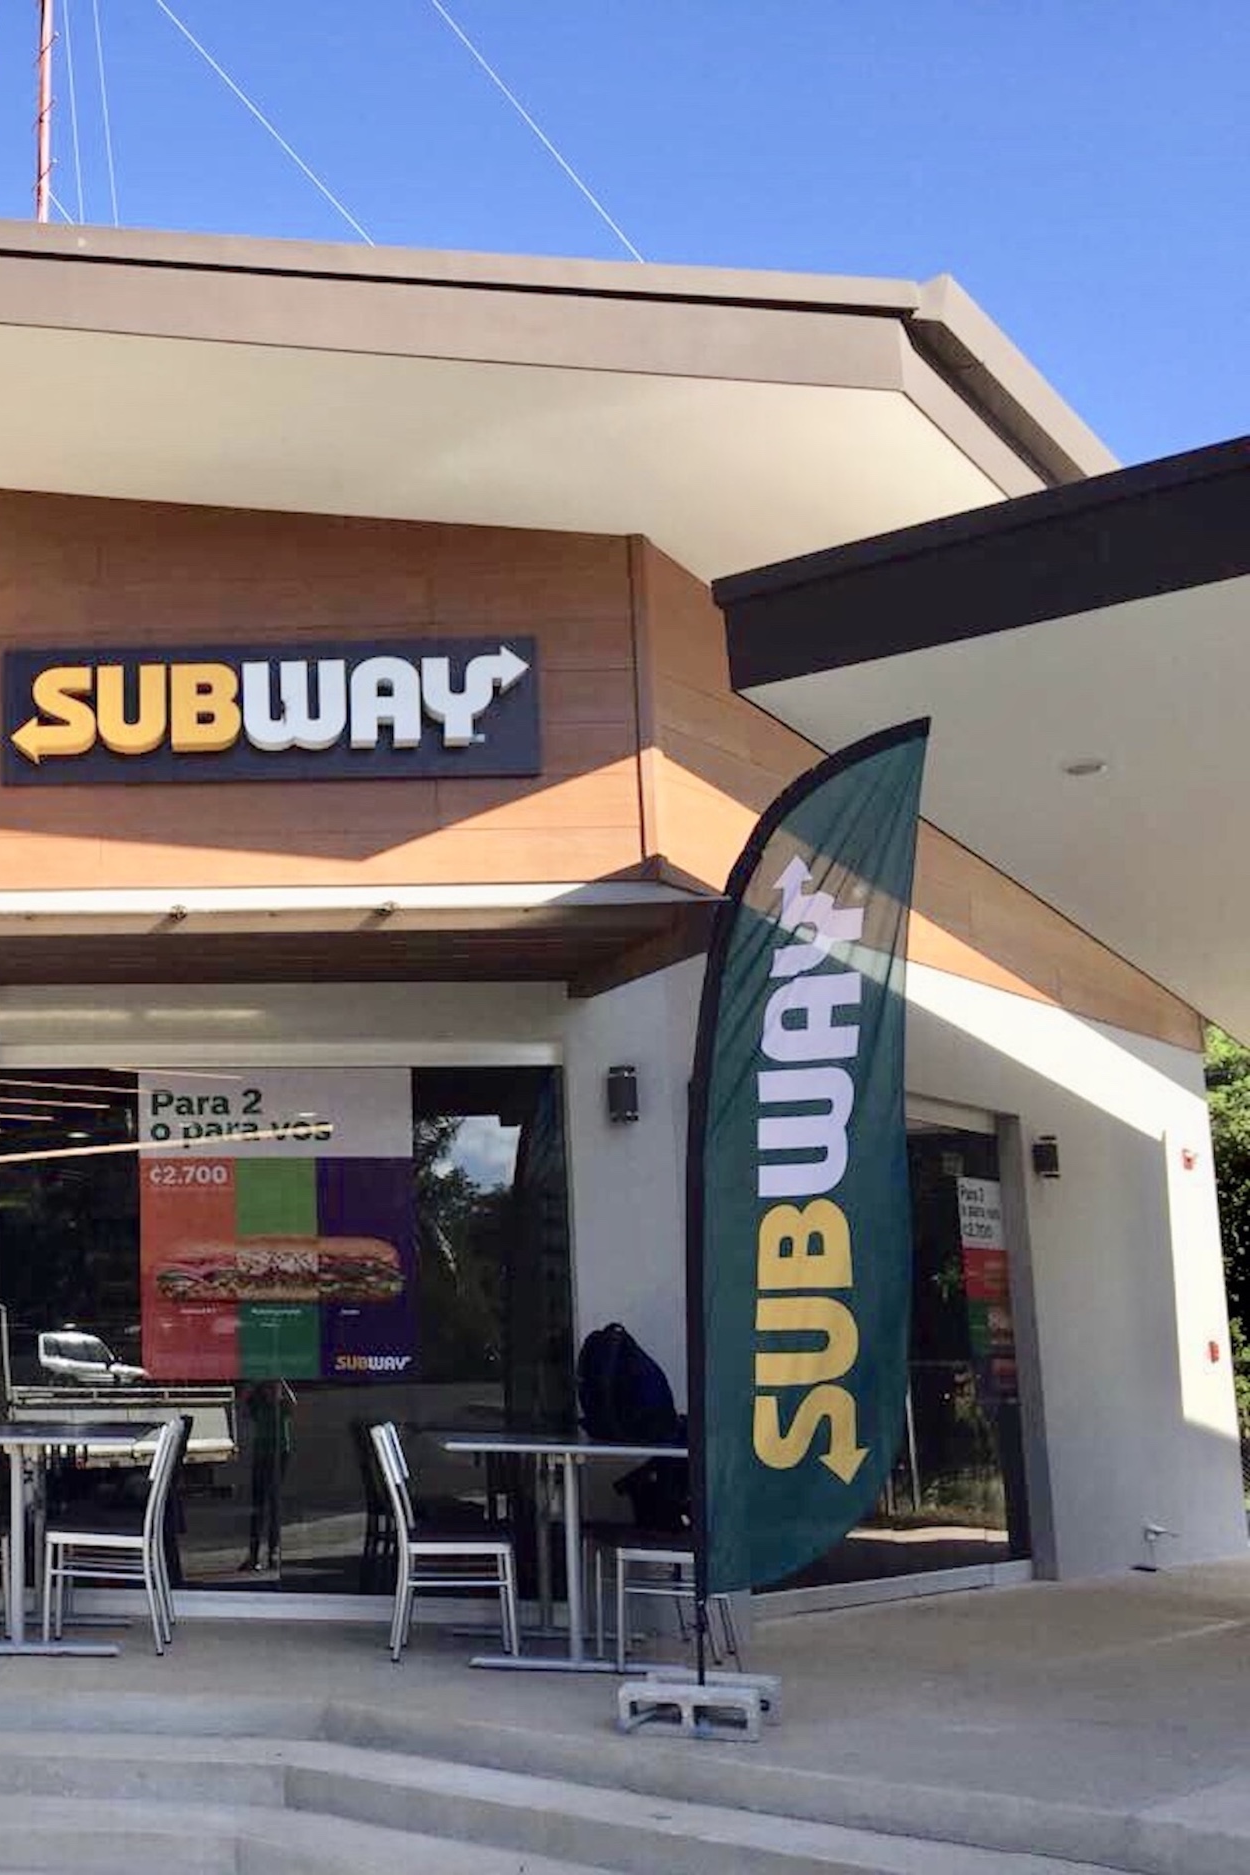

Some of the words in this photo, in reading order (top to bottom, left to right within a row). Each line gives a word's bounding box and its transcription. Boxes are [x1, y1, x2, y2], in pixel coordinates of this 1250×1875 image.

[11, 645, 530, 764] SUBWAY
[151, 1090, 230, 1116] Para
[242, 1088, 263, 1115] 2
[150, 1122, 171, 1141] o
[183, 1122, 259, 1148] para
[271, 1121, 332, 1141] vos
[753, 855, 869, 1485] SUBWAY
[335, 1355, 412, 1371] SUBWAY
